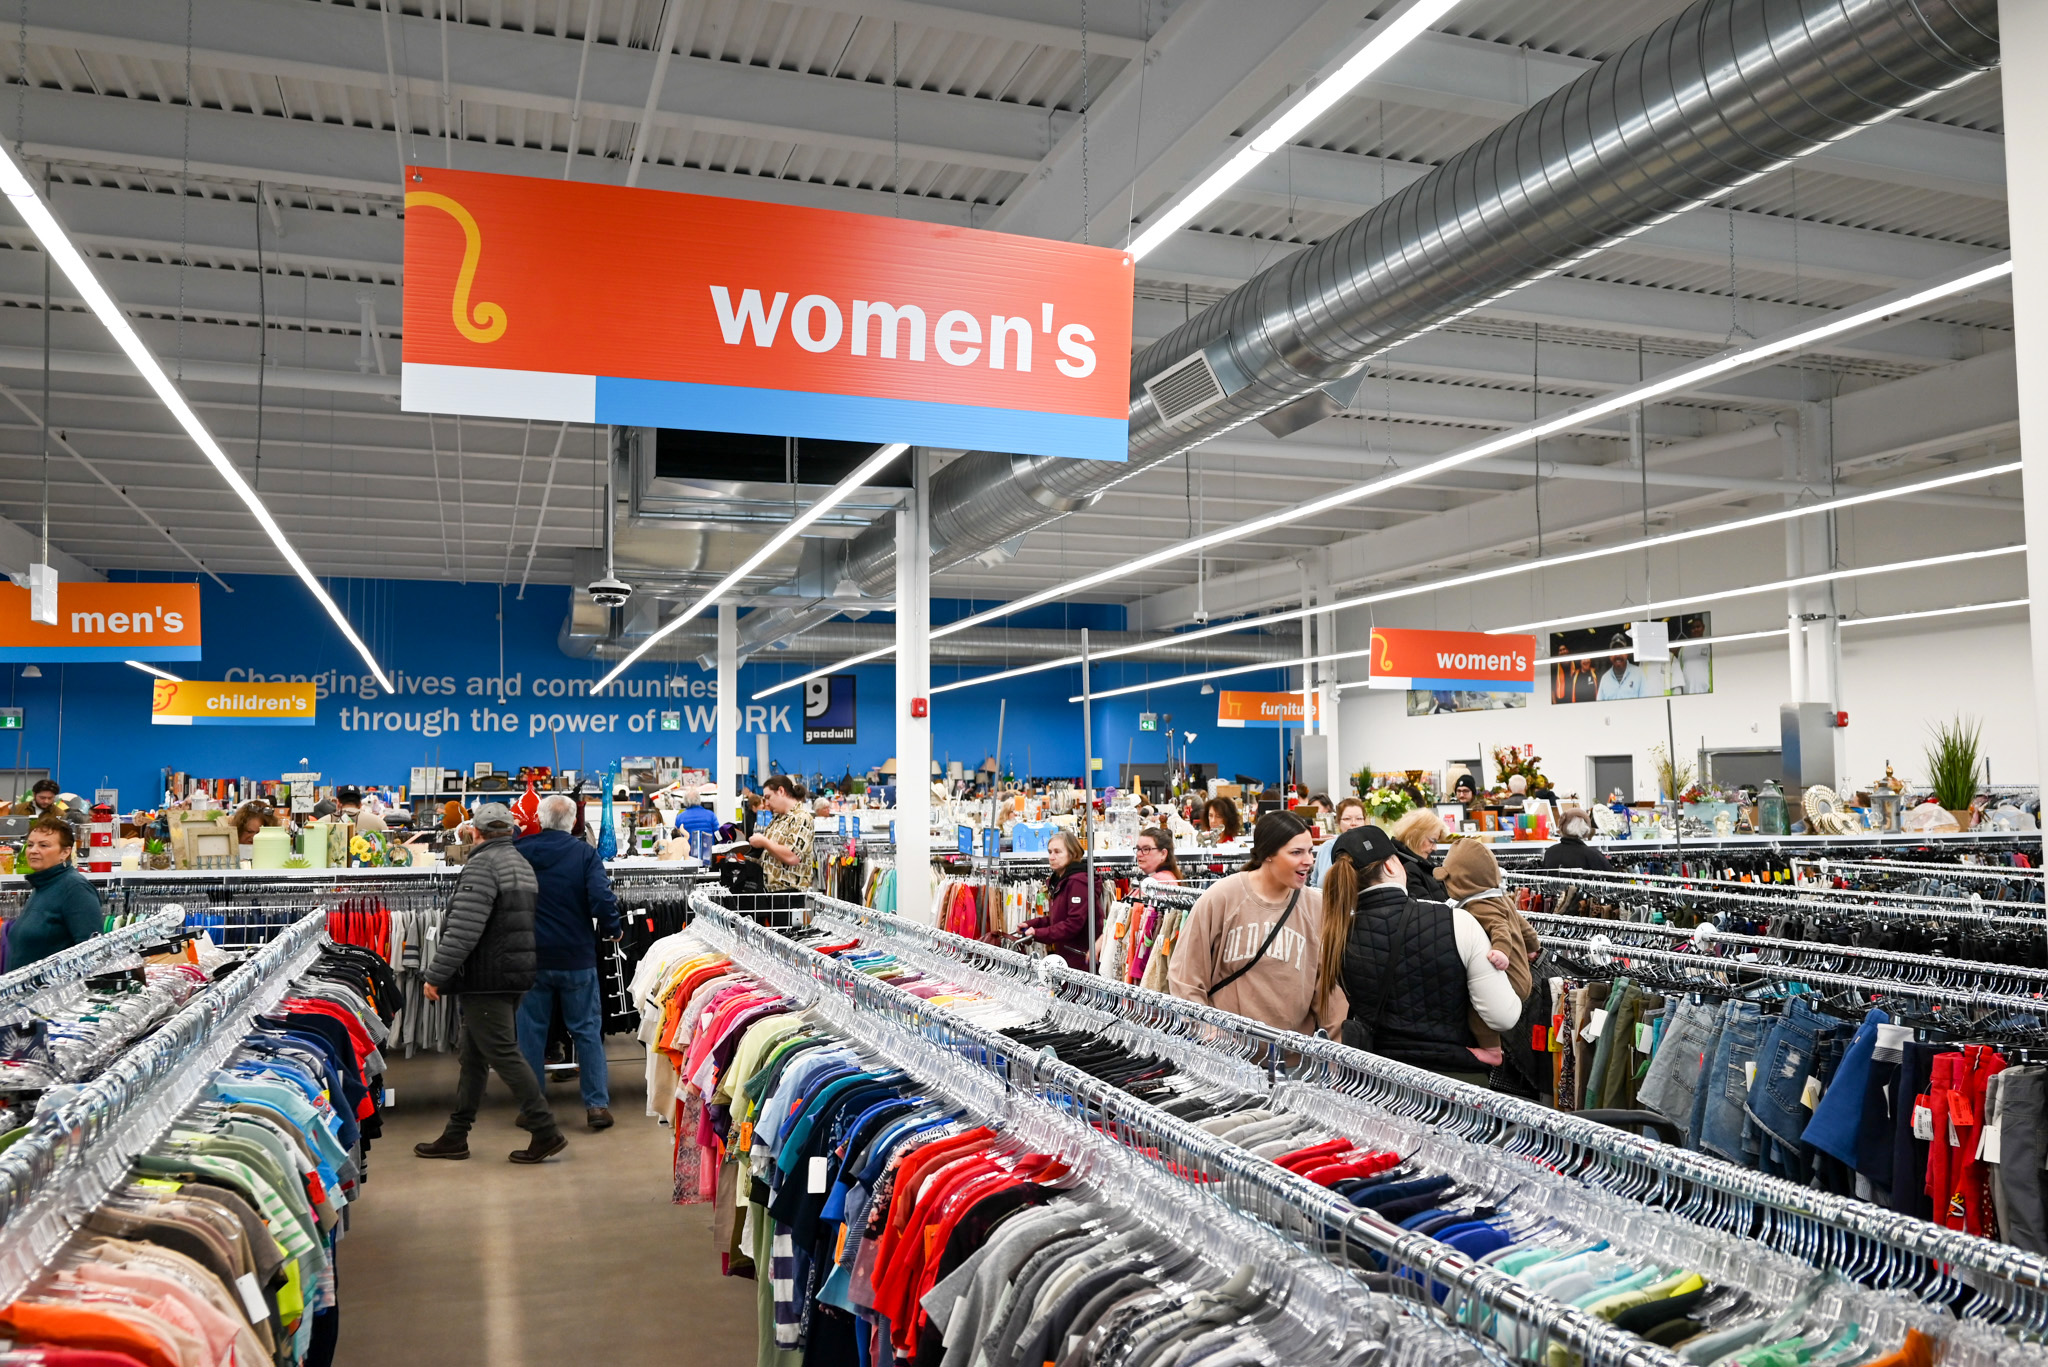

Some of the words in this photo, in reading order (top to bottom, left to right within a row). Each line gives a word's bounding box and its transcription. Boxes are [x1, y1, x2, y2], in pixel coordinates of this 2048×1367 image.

[709, 284, 1097, 378] women's
[71, 606, 184, 633] men's
[1436, 650, 1526, 672] women's
[465, 672, 521, 696] and
[206, 694, 307, 710] children's
[1260, 701, 1317, 716] furnitue
[339, 706, 459, 737] through
[470, 708, 519, 732] the
[529, 709, 619, 737] power
[627, 708, 656, 732] of
[684, 704, 792, 733] WRK
[806, 728, 854, 742] goodwill
[1223, 922, 1259, 963] OLD
[1261, 921, 1306, 971] NAVY
